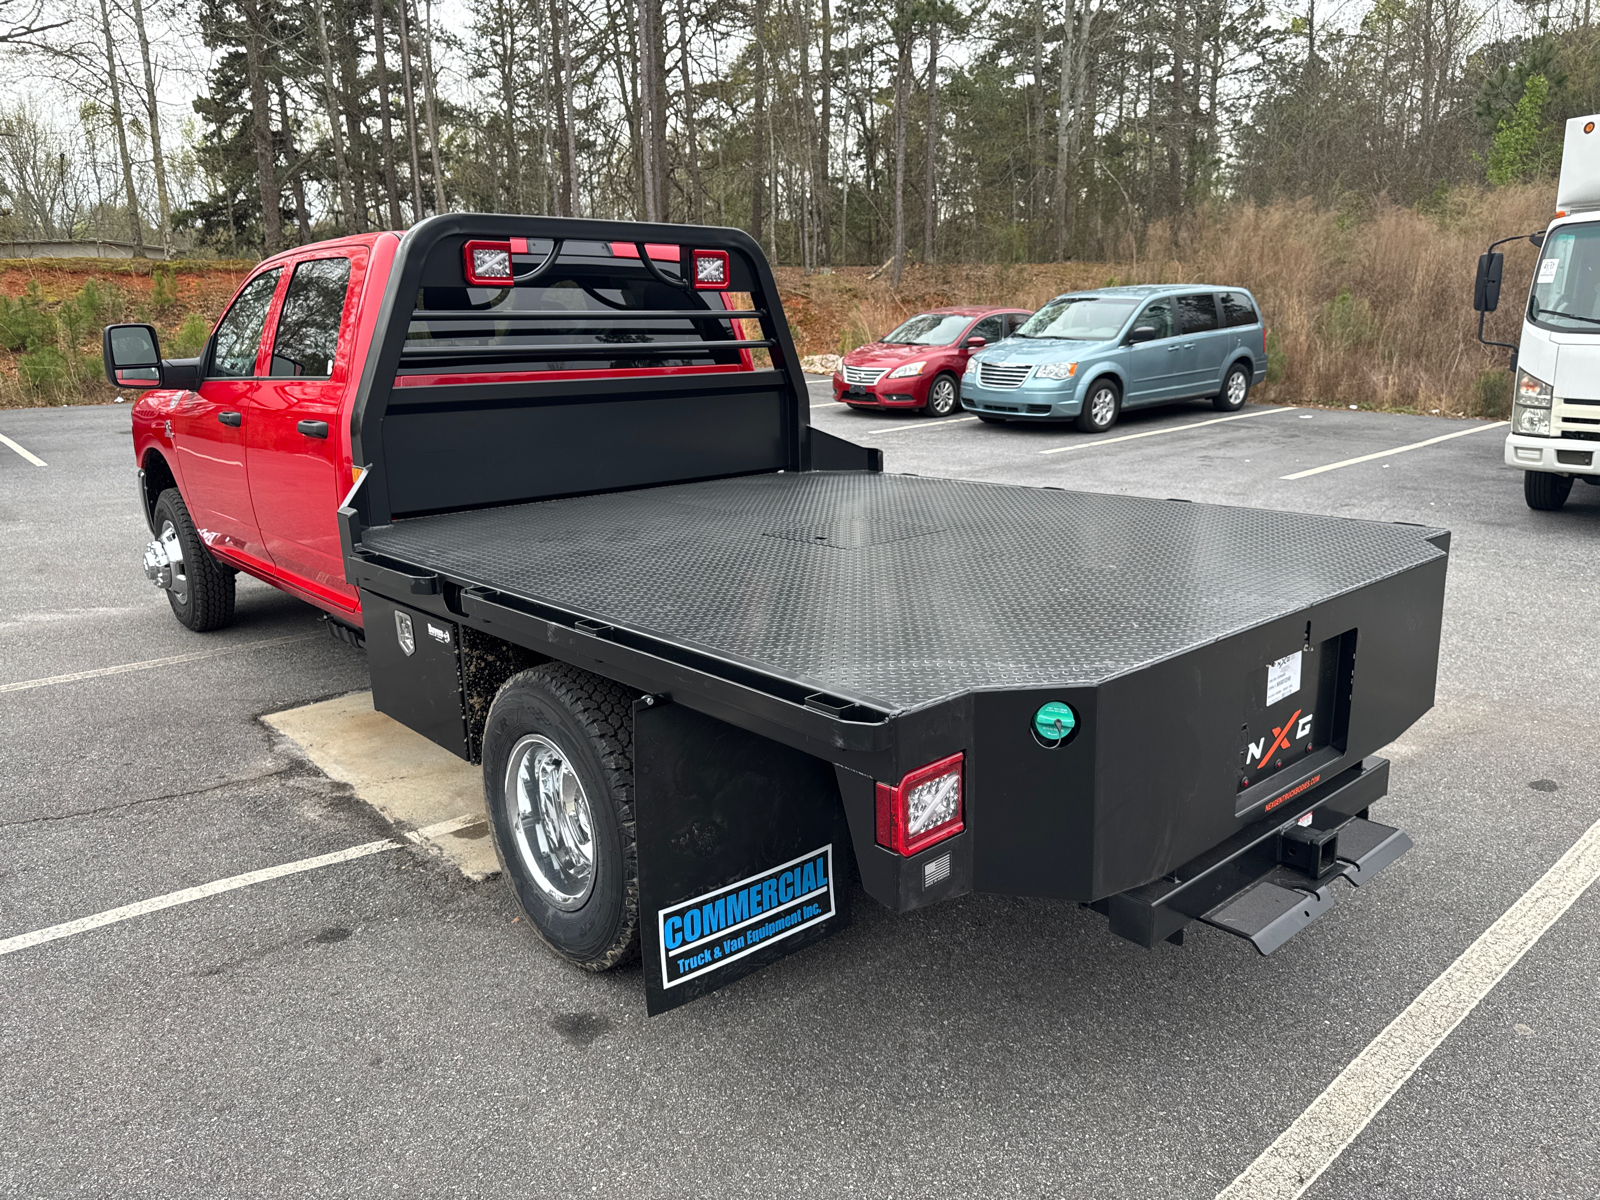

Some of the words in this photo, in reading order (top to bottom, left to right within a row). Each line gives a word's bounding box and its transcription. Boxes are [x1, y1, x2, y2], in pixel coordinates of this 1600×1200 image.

[1246, 709, 1313, 769] NXG
[664, 857, 828, 949] COMMERCIAL
[677, 948, 712, 974] Truck
[713, 946, 722, 959] &
[723, 935, 745, 955] Van
[746, 908, 802, 945] Equipment
[803, 903, 821, 919] Inc.
